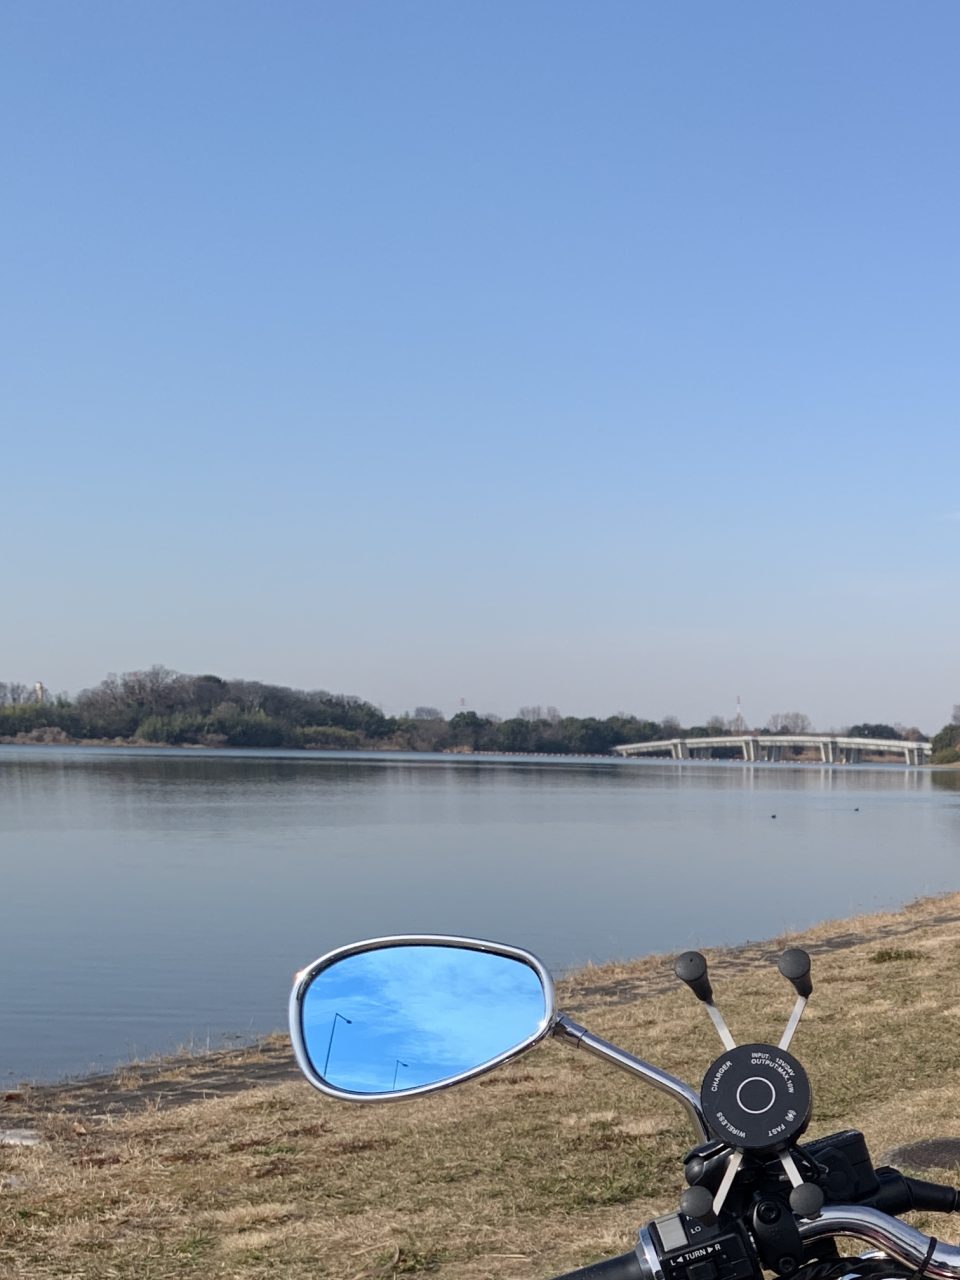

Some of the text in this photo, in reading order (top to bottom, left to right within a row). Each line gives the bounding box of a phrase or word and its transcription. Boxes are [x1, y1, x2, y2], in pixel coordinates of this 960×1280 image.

[711, 1060, 786, 1139] FAST WIRELESS CHARGER
[690, 1225, 702, 1234] LO
[684, 1248, 707, 1261] TURN
[714, 1243, 721, 1251] R
